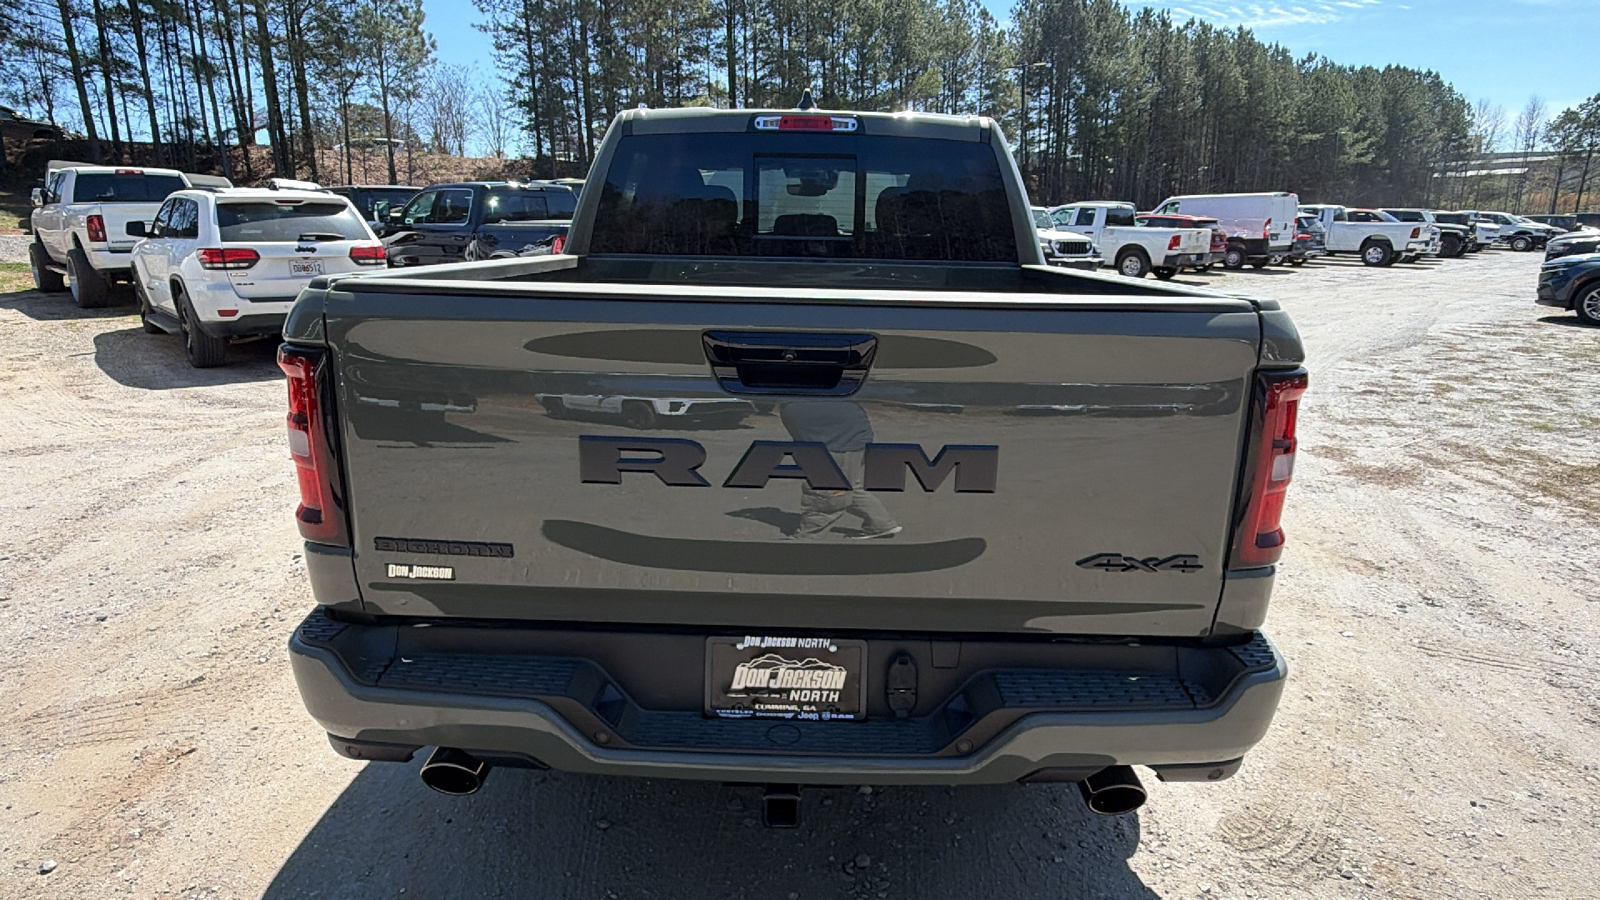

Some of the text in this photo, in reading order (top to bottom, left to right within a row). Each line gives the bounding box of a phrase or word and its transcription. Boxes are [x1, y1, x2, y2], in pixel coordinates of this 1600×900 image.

[578, 435, 999, 493] RAM
[388, 563, 453, 579] DON JACKSON
[743, 635, 831, 649] DON JACKSON NORTH
[730, 666, 848, 690] DON JACKSON
[789, 690, 840, 702] NORTH
[754, 704, 800, 712] CUMMING,
[798, 711, 819, 720] Jeep
